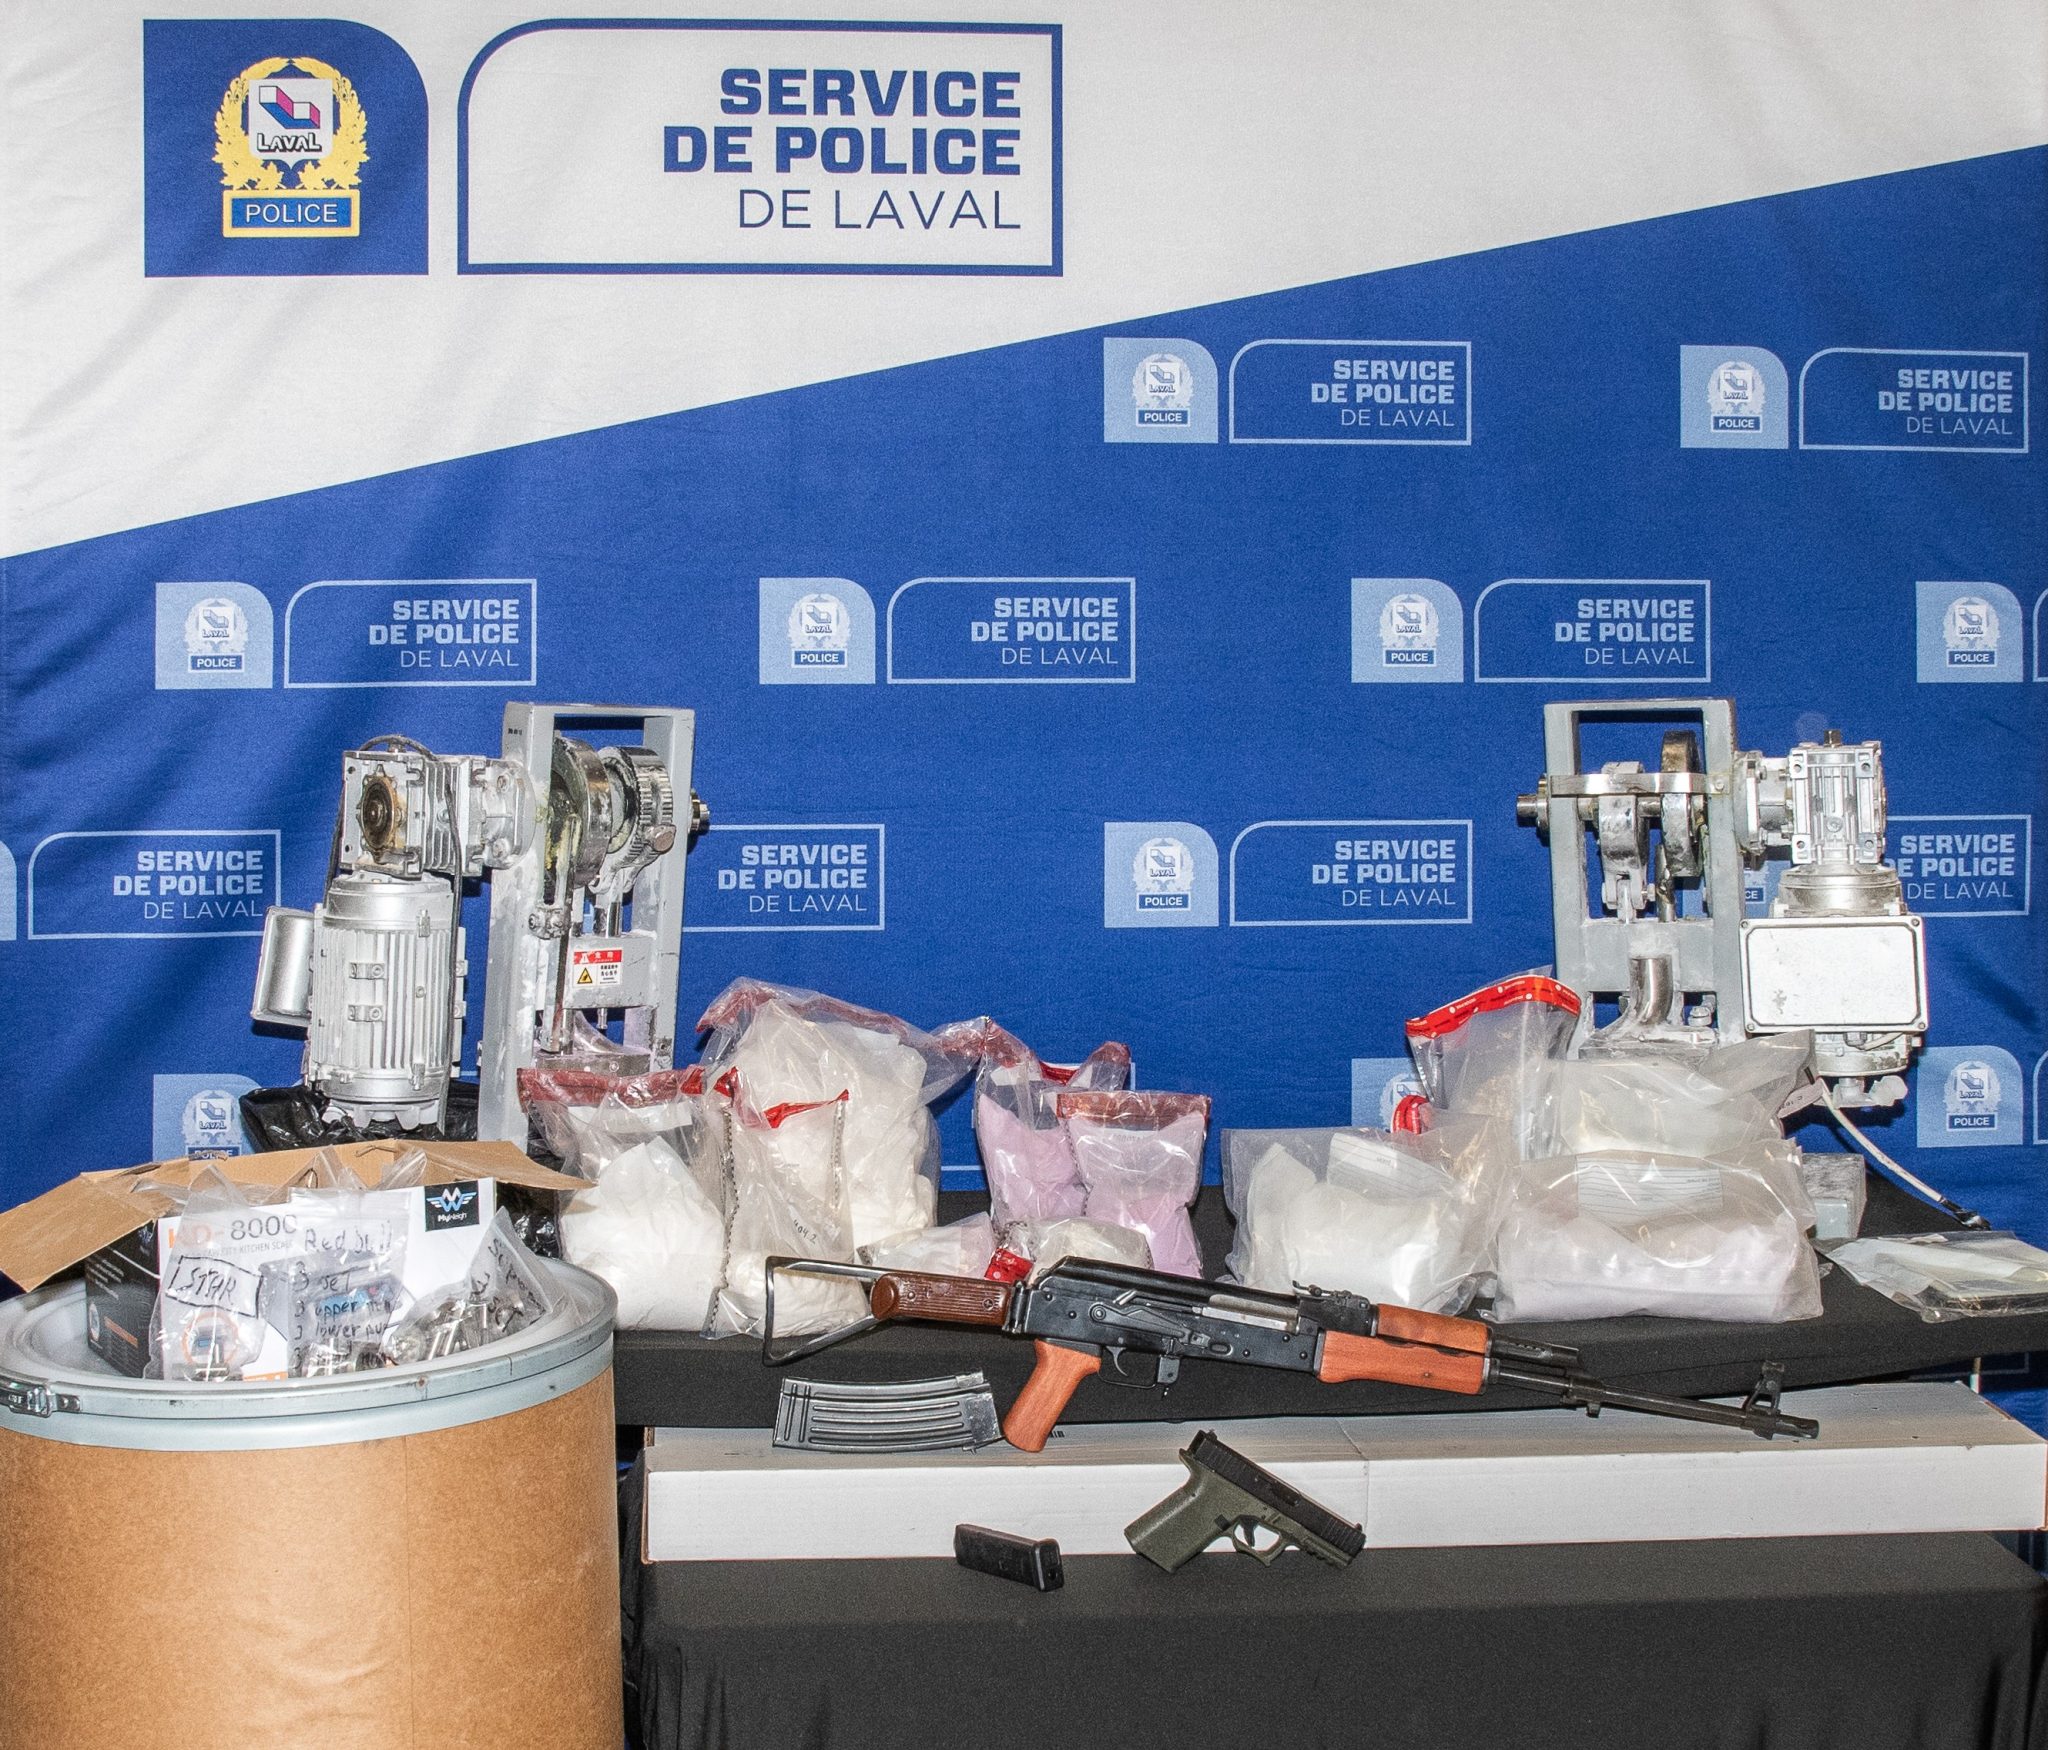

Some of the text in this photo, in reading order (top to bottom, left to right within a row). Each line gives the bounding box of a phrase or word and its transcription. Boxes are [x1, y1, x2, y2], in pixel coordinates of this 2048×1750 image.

[721, 69, 1020, 118] SERVICE
[257, 132, 322, 152] LAVAL
[664, 126, 1020, 175] DE POLICE
[247, 204, 337, 222] POLICE
[740, 189, 1020, 229] DE LAVAL
[1334, 360, 1454, 380] SERVICE
[1149, 384, 1175, 393] LAVAL
[1898, 369, 2012, 390] SERVICE
[1312, 383, 1454, 404] DE POLICE
[1723, 391, 1748, 400] LAVAL
[1879, 391, 2012, 413] DE POLICE
[1144, 413, 1181, 421] POLICE
[1342, 409, 1454, 426] DE LAVAL
[1719, 419, 1754, 428] POLICE
[1907, 417, 2012, 435] DE LAVAL
[394, 599, 519, 620] SERVICE
[995, 598, 1118, 617] SERVICE
[1578, 599, 1694, 618] SERVICE
[202, 628, 229, 638] LAVAL
[370, 624, 518, 645] DE POLICE
[806, 624, 832, 633] LAVAL
[972, 622, 1118, 641] DE POLICE
[1396, 624, 1422, 633] LAVAL
[1555, 623, 1694, 642] DE POLICE
[197, 658, 235, 667] POLICE
[401, 650, 518, 667] DE LAVAL
[801, 654, 838, 662] POLICE
[1002, 647, 1118, 664] DE LAVAL
[1391, 653, 1427, 661] POLICE
[1585, 648, 1694, 664] DE LAVAL
[1954, 654, 1989, 662] POLICE
[1335, 840, 1455, 860] SERVICE
[1901, 834, 2015, 854] SERVICE
[137, 851, 262, 871] SERVICE
[742, 845, 867, 865] SERVICE
[1150, 868, 1176, 877] LAVAL
[1313, 863, 1455, 884] DE POLICE
[1922, 857, 2014, 877] POLICE
[114, 875, 262, 895] DE POLICE
[719, 869, 866, 889] DE POLICE
[1343, 889, 1455, 906] DE LAVAL
[1908, 882, 2012, 899] DE LAVAL
[144, 901, 263, 919] DE LAVAL
[750, 894, 866, 912] DE LAVAL
[1145, 897, 1182, 906] POLICE
[200, 1121, 227, 1130] LAVAL
[1954, 1117, 1989, 1126] POLICE
[240, 1243, 270, 1254] KITCHEN
[176, 1267, 236, 1305] STAR
